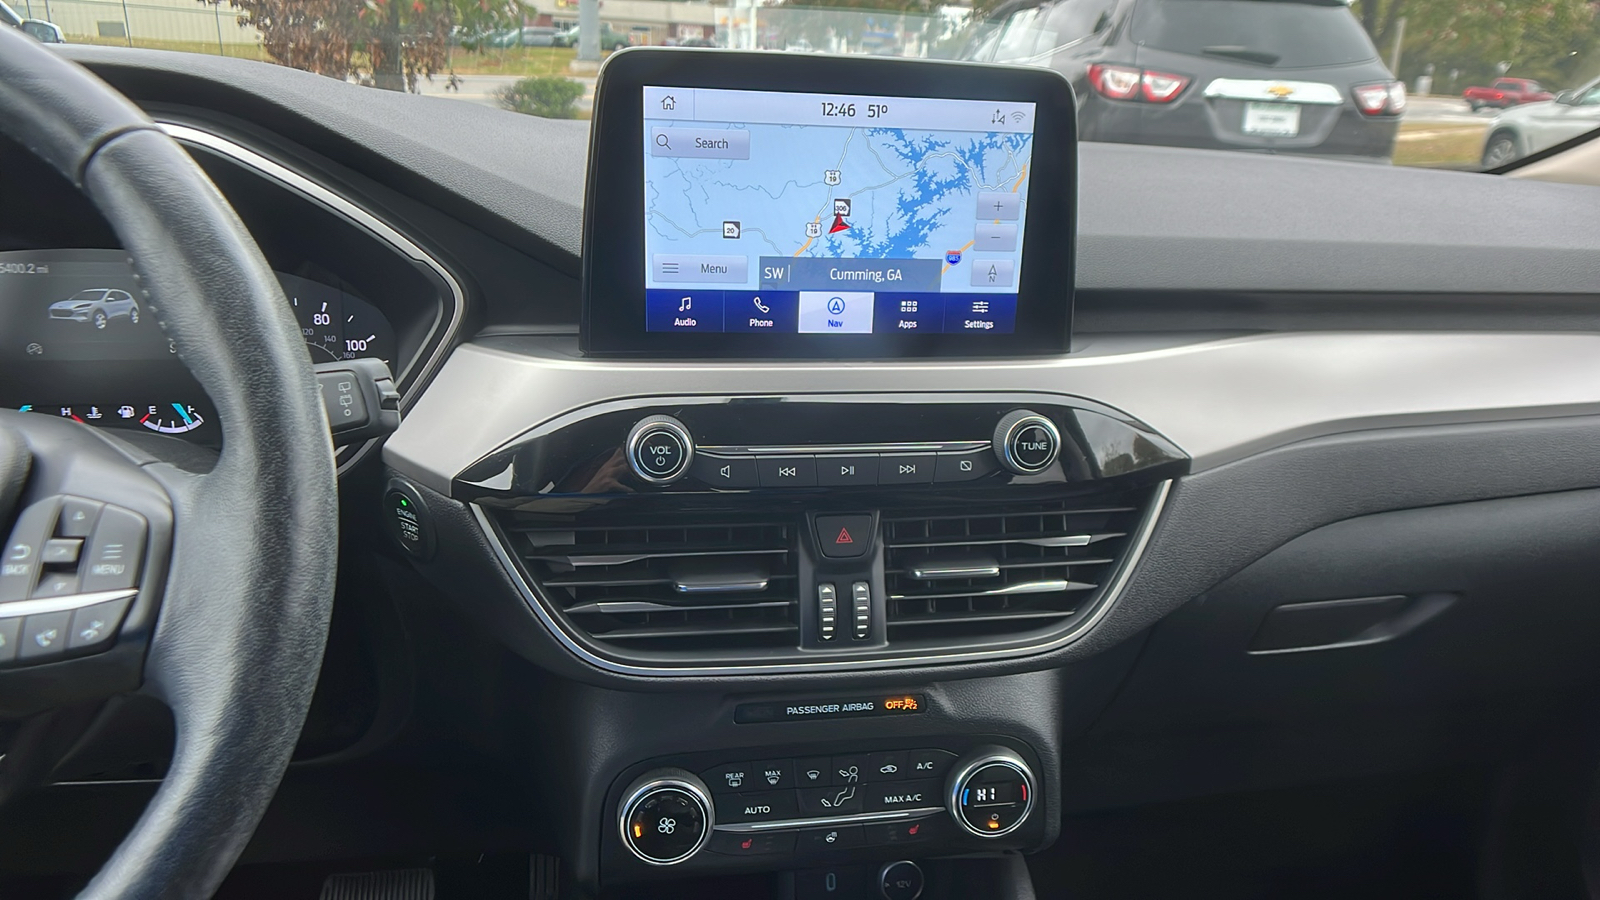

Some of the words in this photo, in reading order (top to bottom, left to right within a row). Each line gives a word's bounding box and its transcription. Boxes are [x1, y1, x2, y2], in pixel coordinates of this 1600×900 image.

[821, 102, 856, 118] 12:46
[695, 137, 729, 150] Search
[701, 263, 728, 274] Menu
[764, 267, 784, 279] SW
[830, 268, 885, 283] Cumming,
[887, 269, 902, 281] GA
[313, 313, 330, 325] 80
[674, 317, 697, 327] Audio
[749, 318, 773, 328] Phone
[827, 319, 843, 328] Nav
[898, 320, 917, 330] Apps
[964, 320, 994, 331] Settings
[345, 340, 367, 351] 100
[649, 445, 672, 456] VOL
[1021, 441, 1047, 452] TUNE
[786, 705, 840, 716] PASSENGER
[842, 702, 875, 713] AIRBAG
[884, 700, 903, 711] OFF
[916, 762, 933, 770] A/C
[884, 796, 905, 804] MAX
[906, 793, 922, 802] A/C
[744, 805, 771, 815] AUTO
